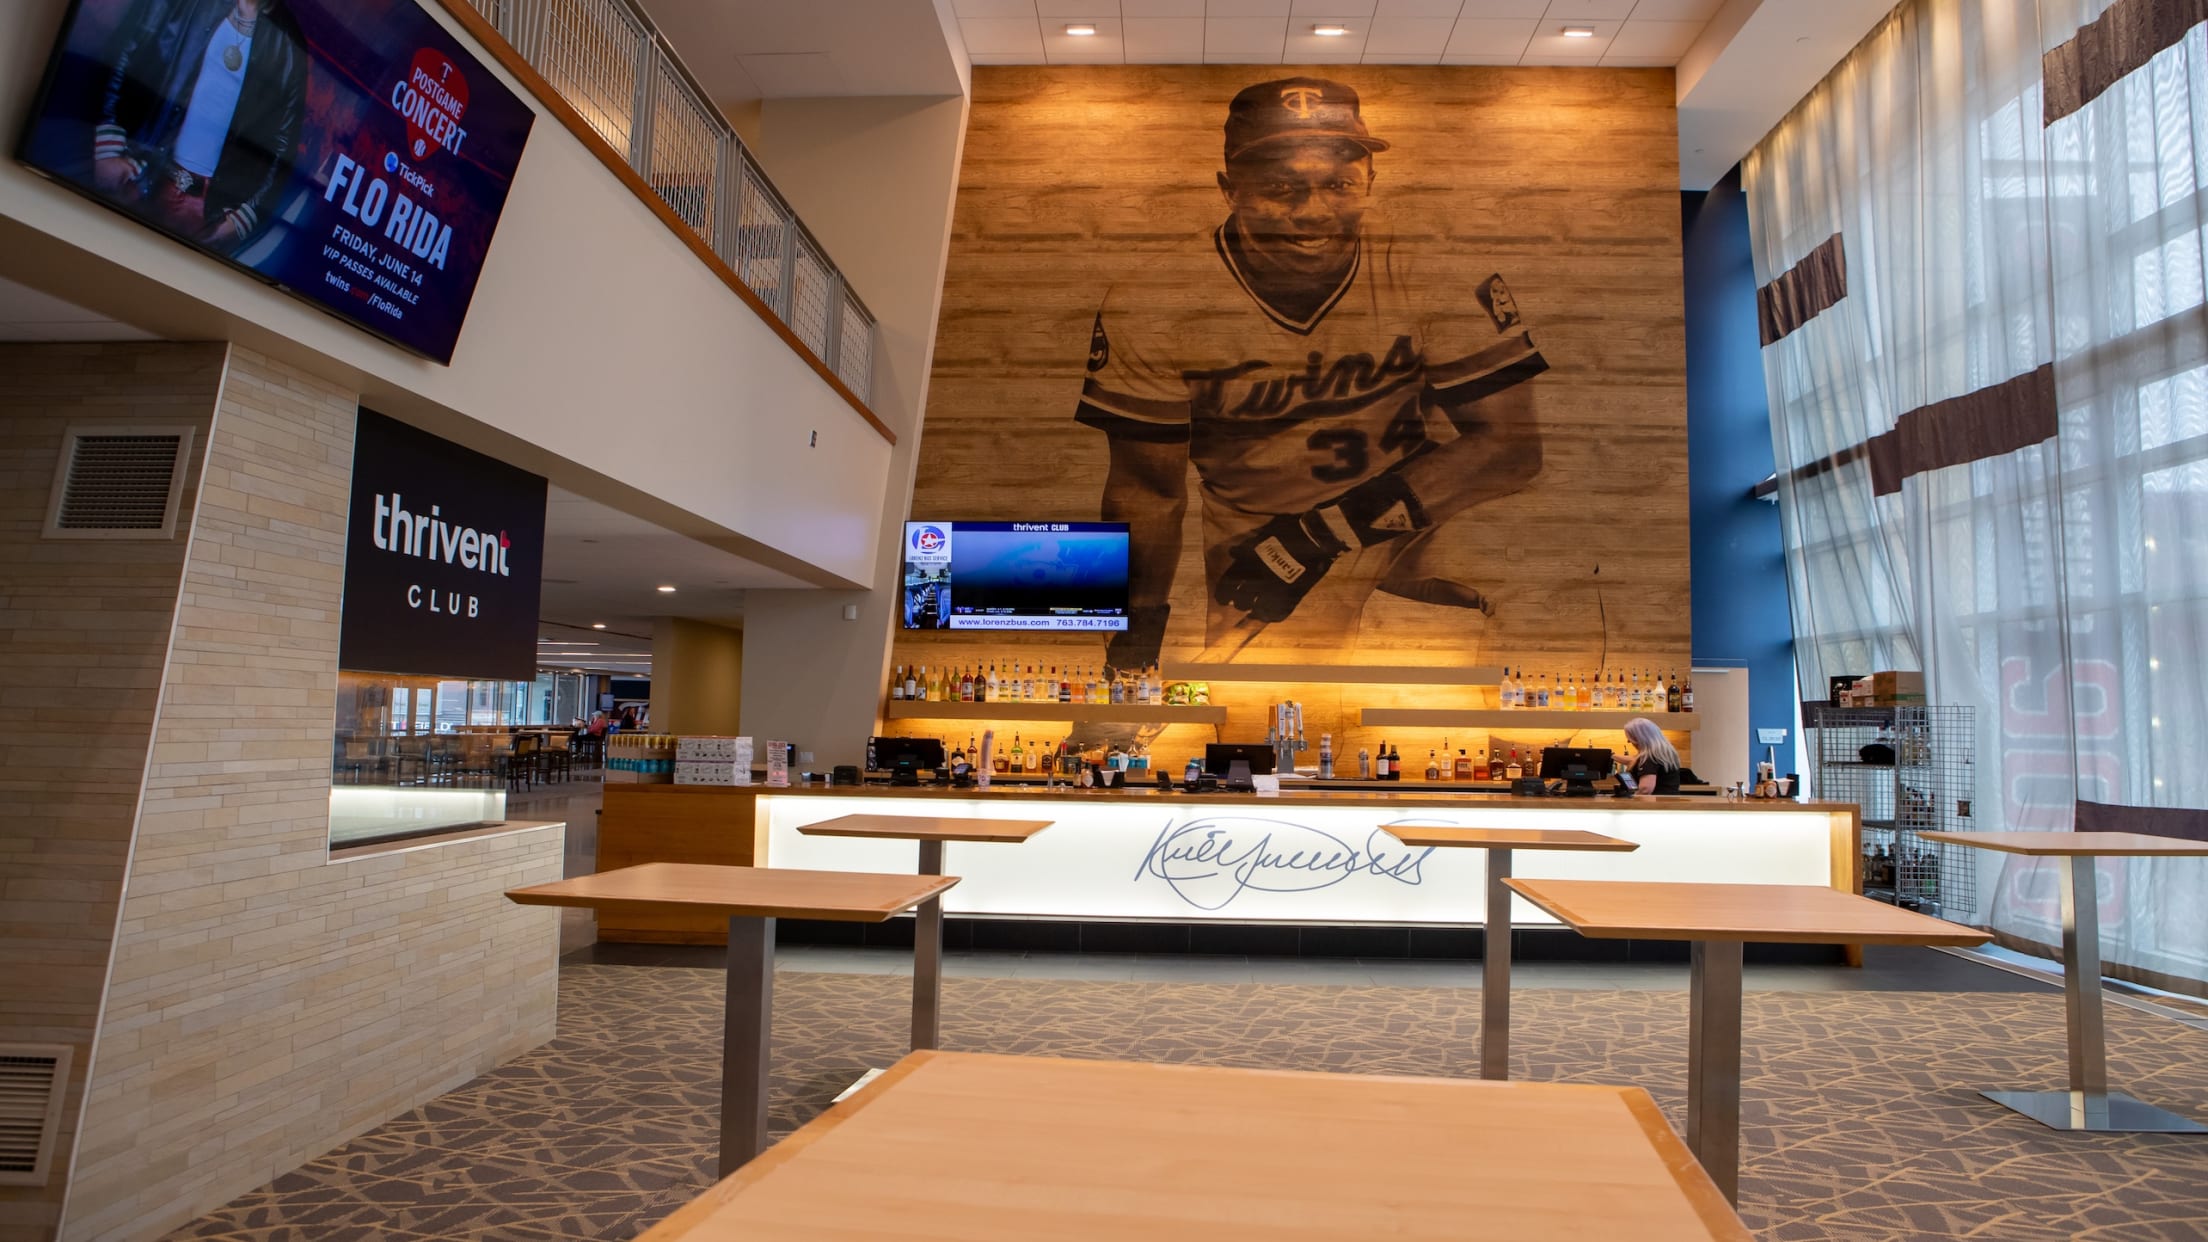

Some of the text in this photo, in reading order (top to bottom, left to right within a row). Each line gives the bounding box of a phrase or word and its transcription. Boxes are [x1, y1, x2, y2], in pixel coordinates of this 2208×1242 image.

[392, 80, 468, 156] CONCERT
[412, 66, 464, 120] POSTGAME
[399, 162, 435, 198] TickPick
[324, 152, 453, 271] FLO RIDA
[322, 244, 420, 306] VIP PASSES AVAILABLE
[332, 224, 424, 287] FRIDAY, JUNE 14
[1182, 335, 1425, 418] Twins
[1306, 394, 1427, 484] 34
[373, 492, 512, 577] thrivent
[1013, 522, 1069, 532] thrivent CLUB
[407, 584, 479, 618] CLUB
[958, 618, 1120, 627] www.lorenzbus.com 763.784.7196
